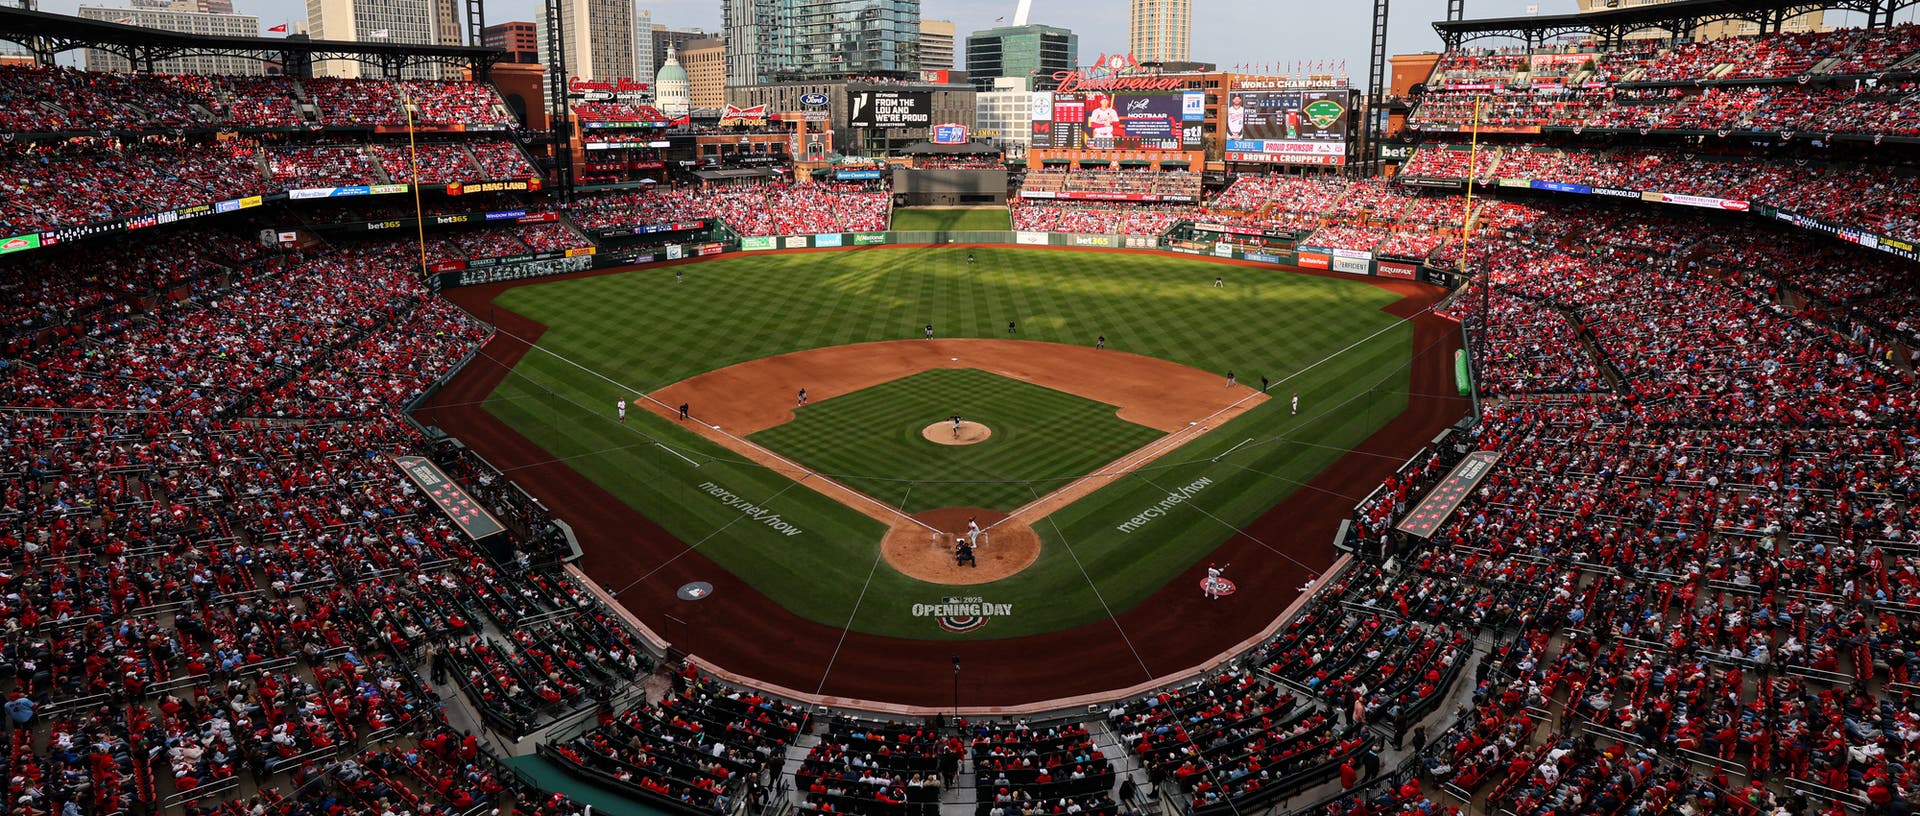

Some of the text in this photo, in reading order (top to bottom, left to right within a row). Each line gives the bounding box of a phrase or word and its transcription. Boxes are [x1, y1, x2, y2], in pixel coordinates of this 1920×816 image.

[569, 76, 613, 92] Cardinals
[1053, 70, 1182, 93] Budweiser
[1241, 80, 1338, 89] WORLD CHAMPIONS
[875, 98, 915, 107] FROM THE
[722, 106, 764, 118] Budweiser
[875, 106, 909, 114] LOU AND
[720, 118, 767, 127] BREW HOUSE
[875, 114, 928, 122] WE'RE PROUD
[1234, 141, 1255, 149] STIFEL
[1265, 143, 1314, 152] PROUD SPONSOR
[1242, 153, 1271, 161] BROWN
[1280, 155, 1325, 163] CROUPPEN
[482, 183, 504, 191] MAC
[504, 182, 528, 190] LAND
[1591, 187, 1640, 198] LINDENWOOD.EDU
[437, 215, 468, 224] bet365
[368, 221, 401, 230] bet365
[1076, 236, 1109, 245] bet365
[1380, 265, 1412, 275] EQUIFAX
[698, 481, 802, 536] mercy.net/now
[1116, 476, 1213, 534] mercy.net/now
[912, 602, 1013, 617] OPENING DAY
